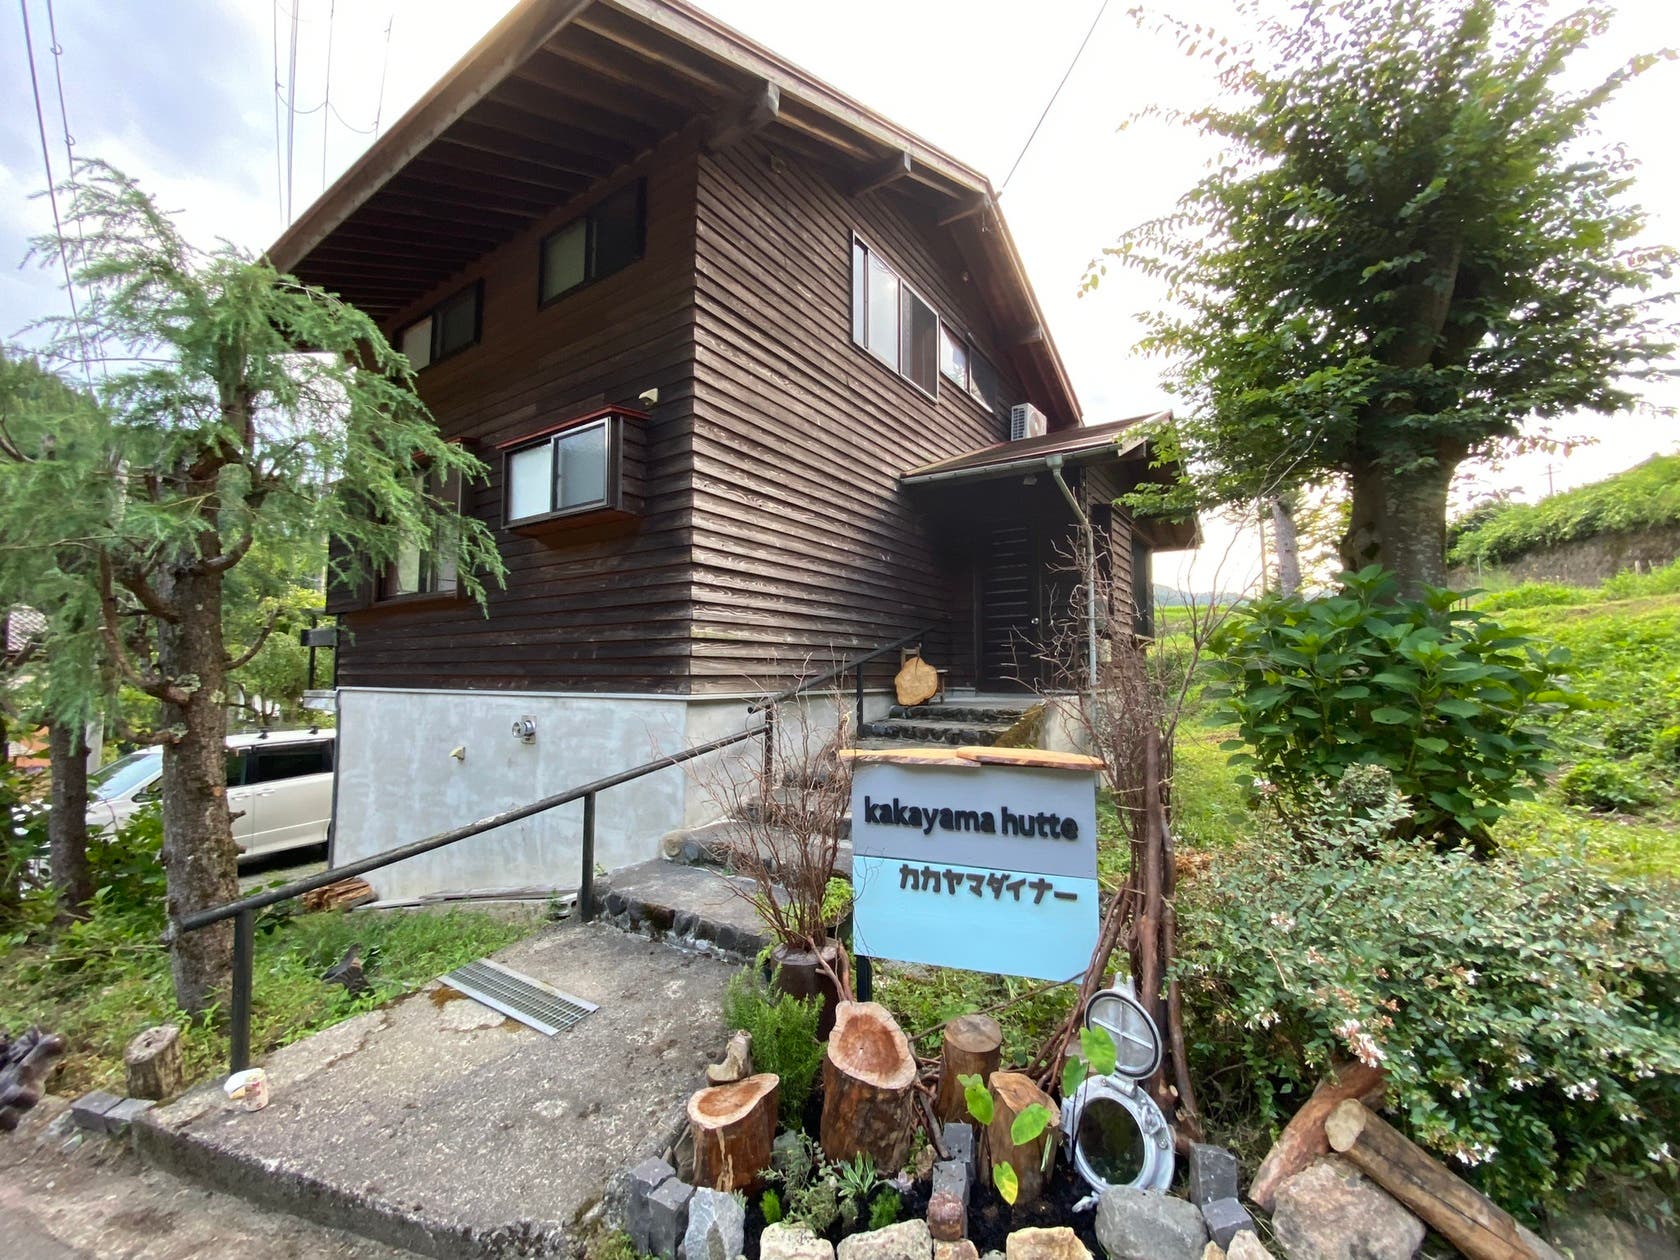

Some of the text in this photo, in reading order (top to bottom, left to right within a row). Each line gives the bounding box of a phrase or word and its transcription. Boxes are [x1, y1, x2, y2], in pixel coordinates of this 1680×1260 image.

[864, 796, 1079, 840] kakayama hutte
[899, 863, 1078, 904] カカヤマダイナー
